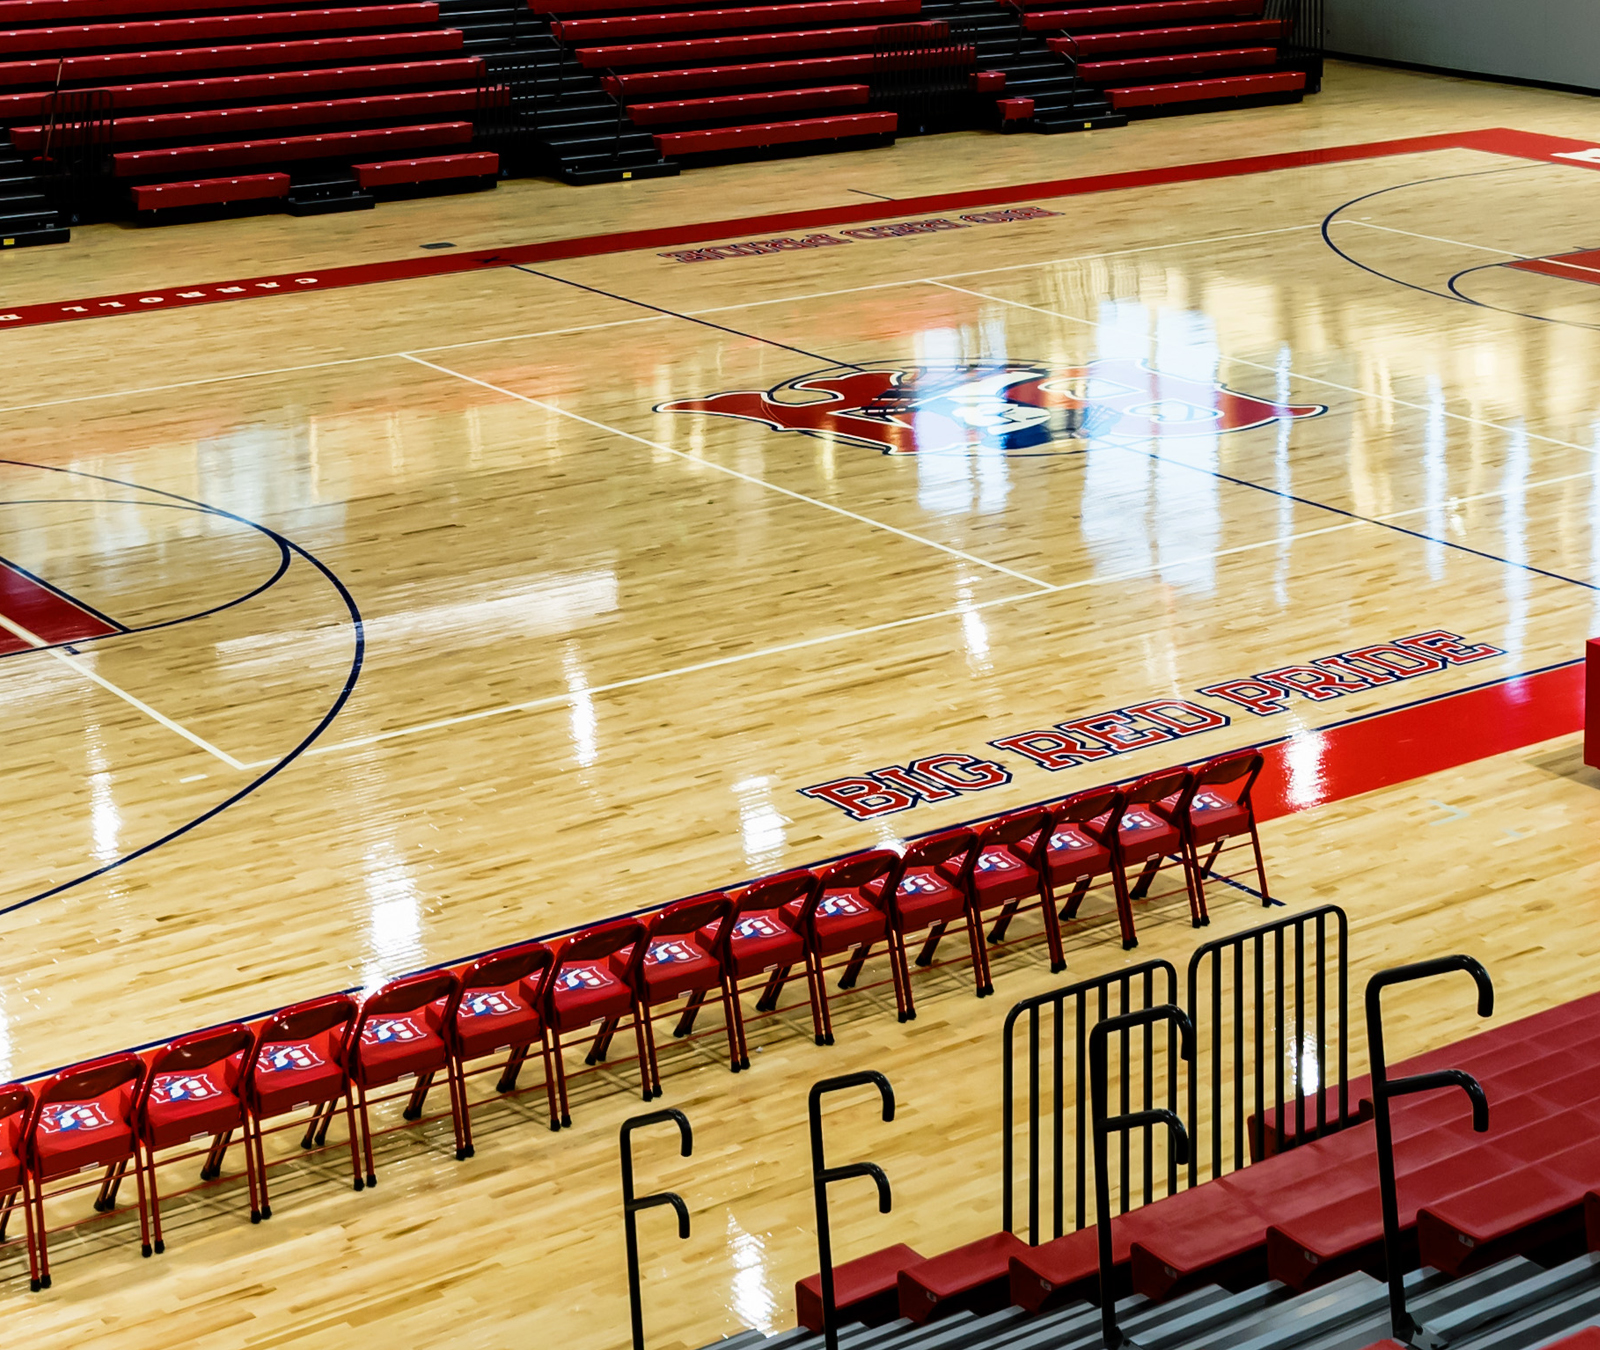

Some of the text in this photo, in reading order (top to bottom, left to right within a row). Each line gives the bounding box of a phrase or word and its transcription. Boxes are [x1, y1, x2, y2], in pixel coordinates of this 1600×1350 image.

[796, 628, 1508, 823] BIG RED PRIDE
